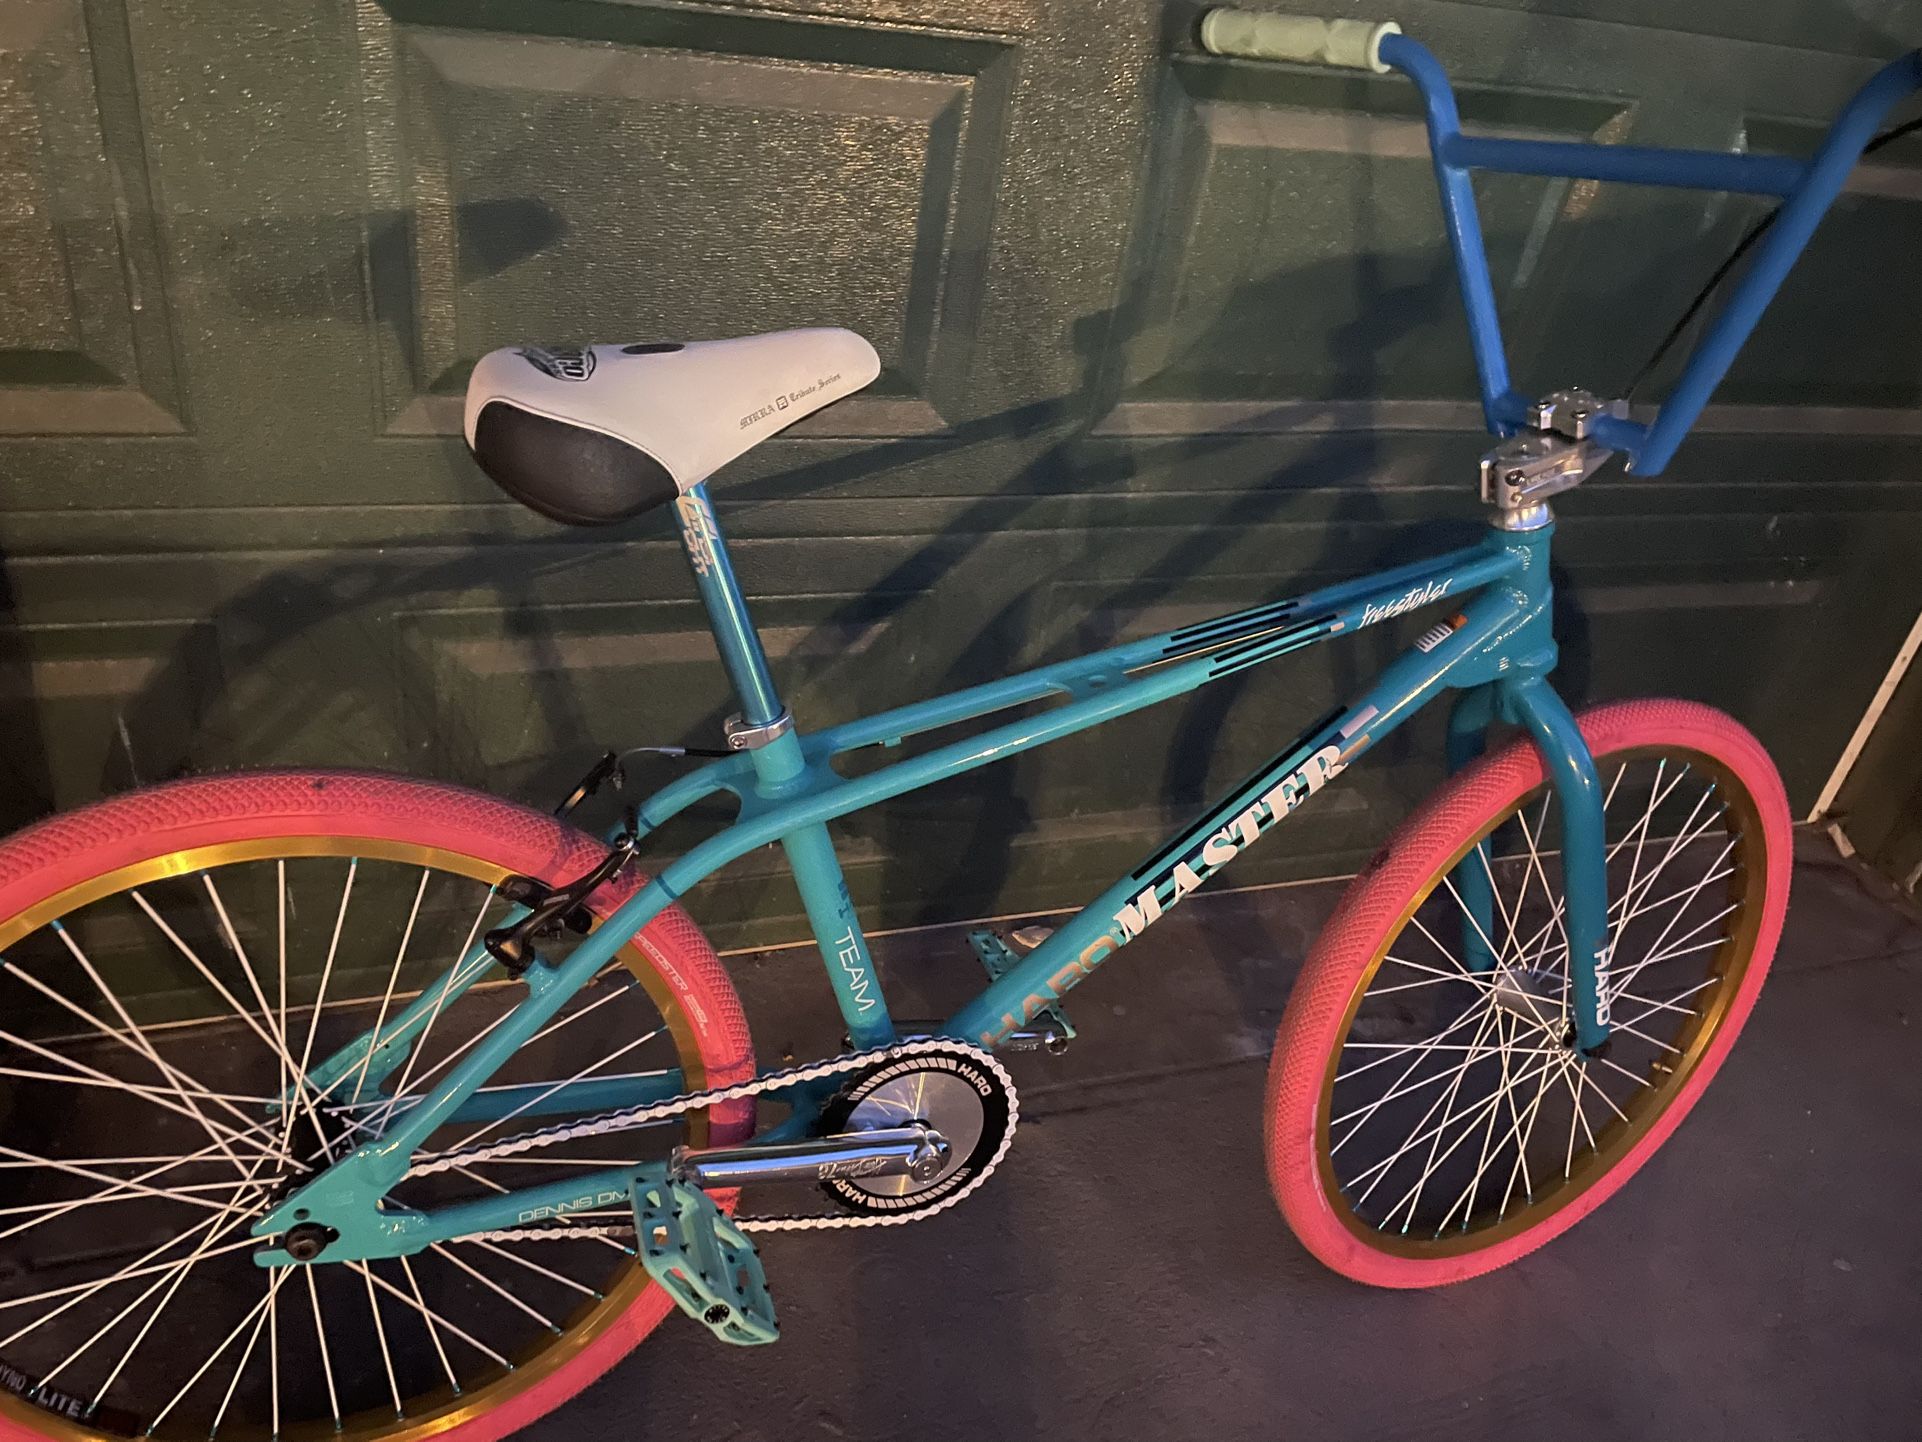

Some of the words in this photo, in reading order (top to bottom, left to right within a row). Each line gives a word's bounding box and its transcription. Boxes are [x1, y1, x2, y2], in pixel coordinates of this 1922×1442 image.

[1113, 744, 1349, 944] MASTER
[835, 925, 876, 1012] TEAM
[957, 1063, 992, 1097] HARO
[518, 1196, 593, 1223] DENNIS
[597, 1190, 632, 1205] DM
[38, 1386, 82, 1417] LITE
